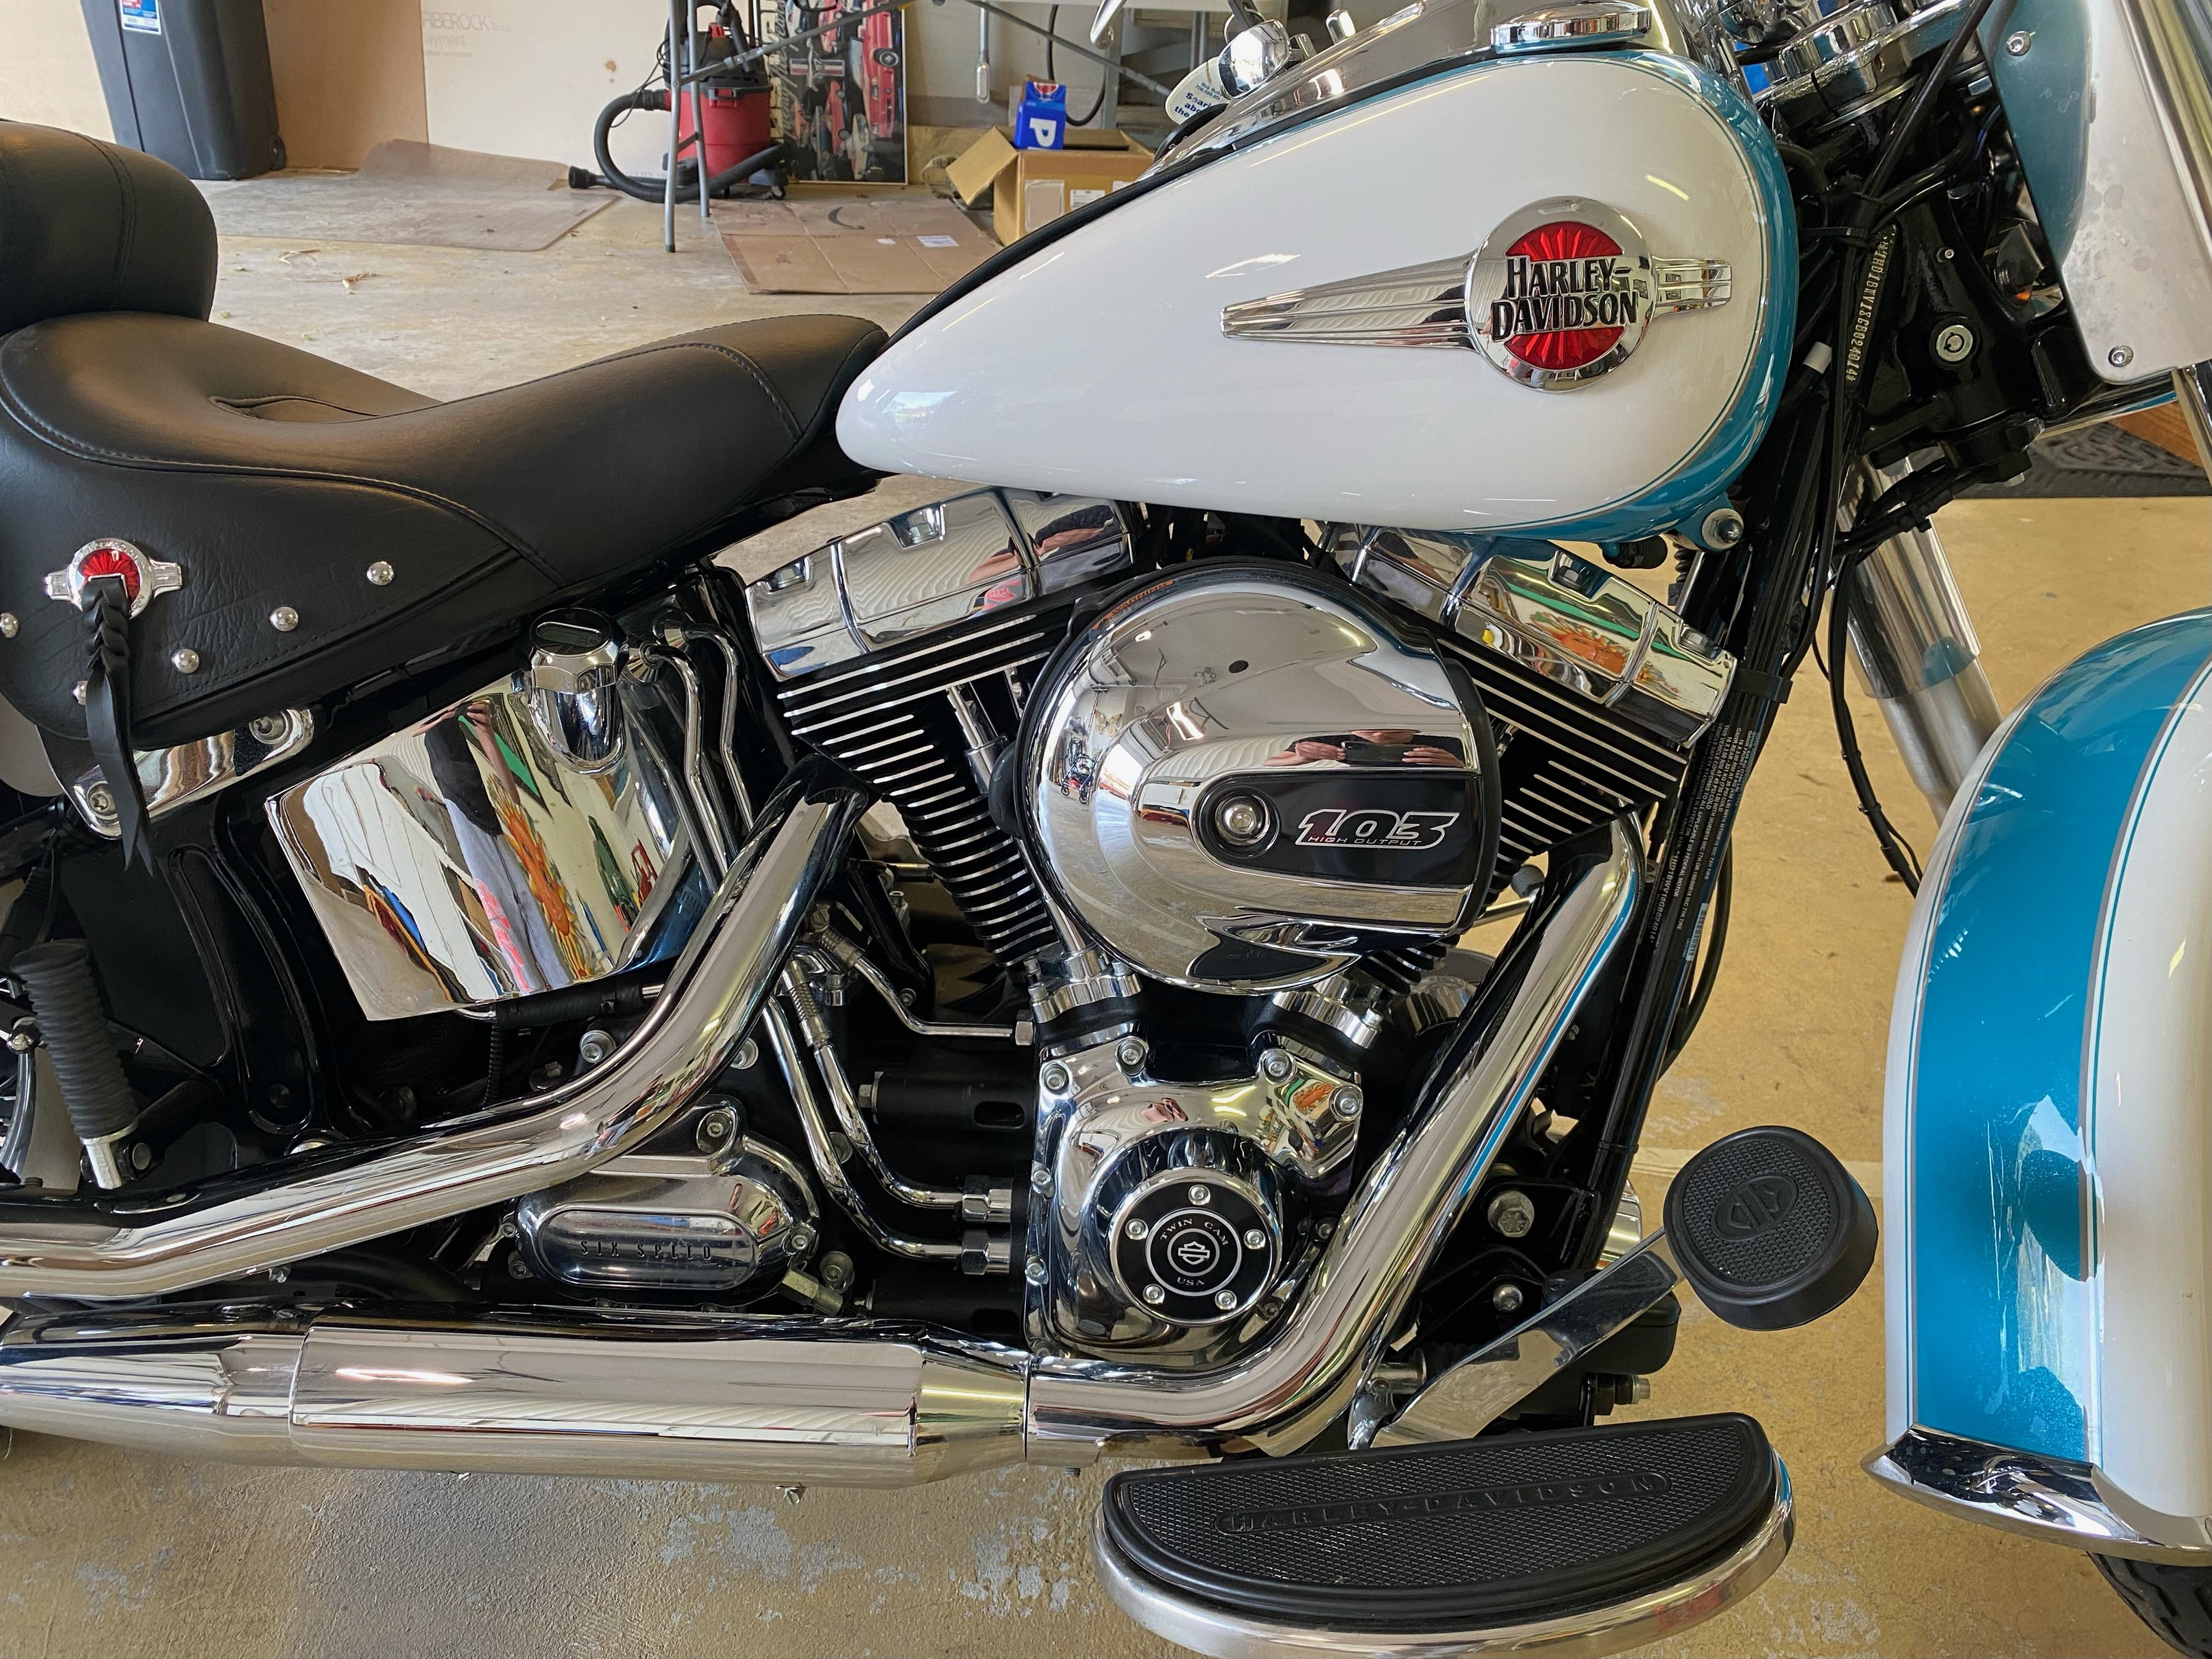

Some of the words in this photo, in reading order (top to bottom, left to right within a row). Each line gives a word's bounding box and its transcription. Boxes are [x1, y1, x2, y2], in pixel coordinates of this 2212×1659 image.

[1173, 105, 1190, 118] the
[1507, 256, 1632, 300] HARLEY-
[1491, 291, 1639, 341] DAVIDSON
[1713, 721, 1722, 746] VEHICLE
[1733, 726, 1741, 744] GAWR
[1706, 745, 1715, 767] SAFETY
[1715, 736, 1724, 760] VEHICLE
[1728, 744, 1736, 760] REAR
[1696, 767, 1708, 800] STANDARDS
[1705, 760, 1717, 792] CONFORMS
[1706, 793, 1714, 810] COLD
[1718, 796, 1726, 812] COLD
[1688, 806, 1696, 827] EFFECT
[1690, 810, 1702, 843] APPLICABLE
[1295, 809, 1460, 850] 103
[1679, 851, 1689, 877] FEDERAL
[1673, 877, 1682, 897] MOTOR
[1160, 1218, 1193, 1241] TWIN
[1204, 1221, 1229, 1246] CAM
[580, 1240, 620, 1257] SIX
[636, 1242, 712, 1261] SPEED
[1176, 1277, 1205, 1286] USA
[1229, 1475, 1656, 1532] HARLEY-DAVIDSON
